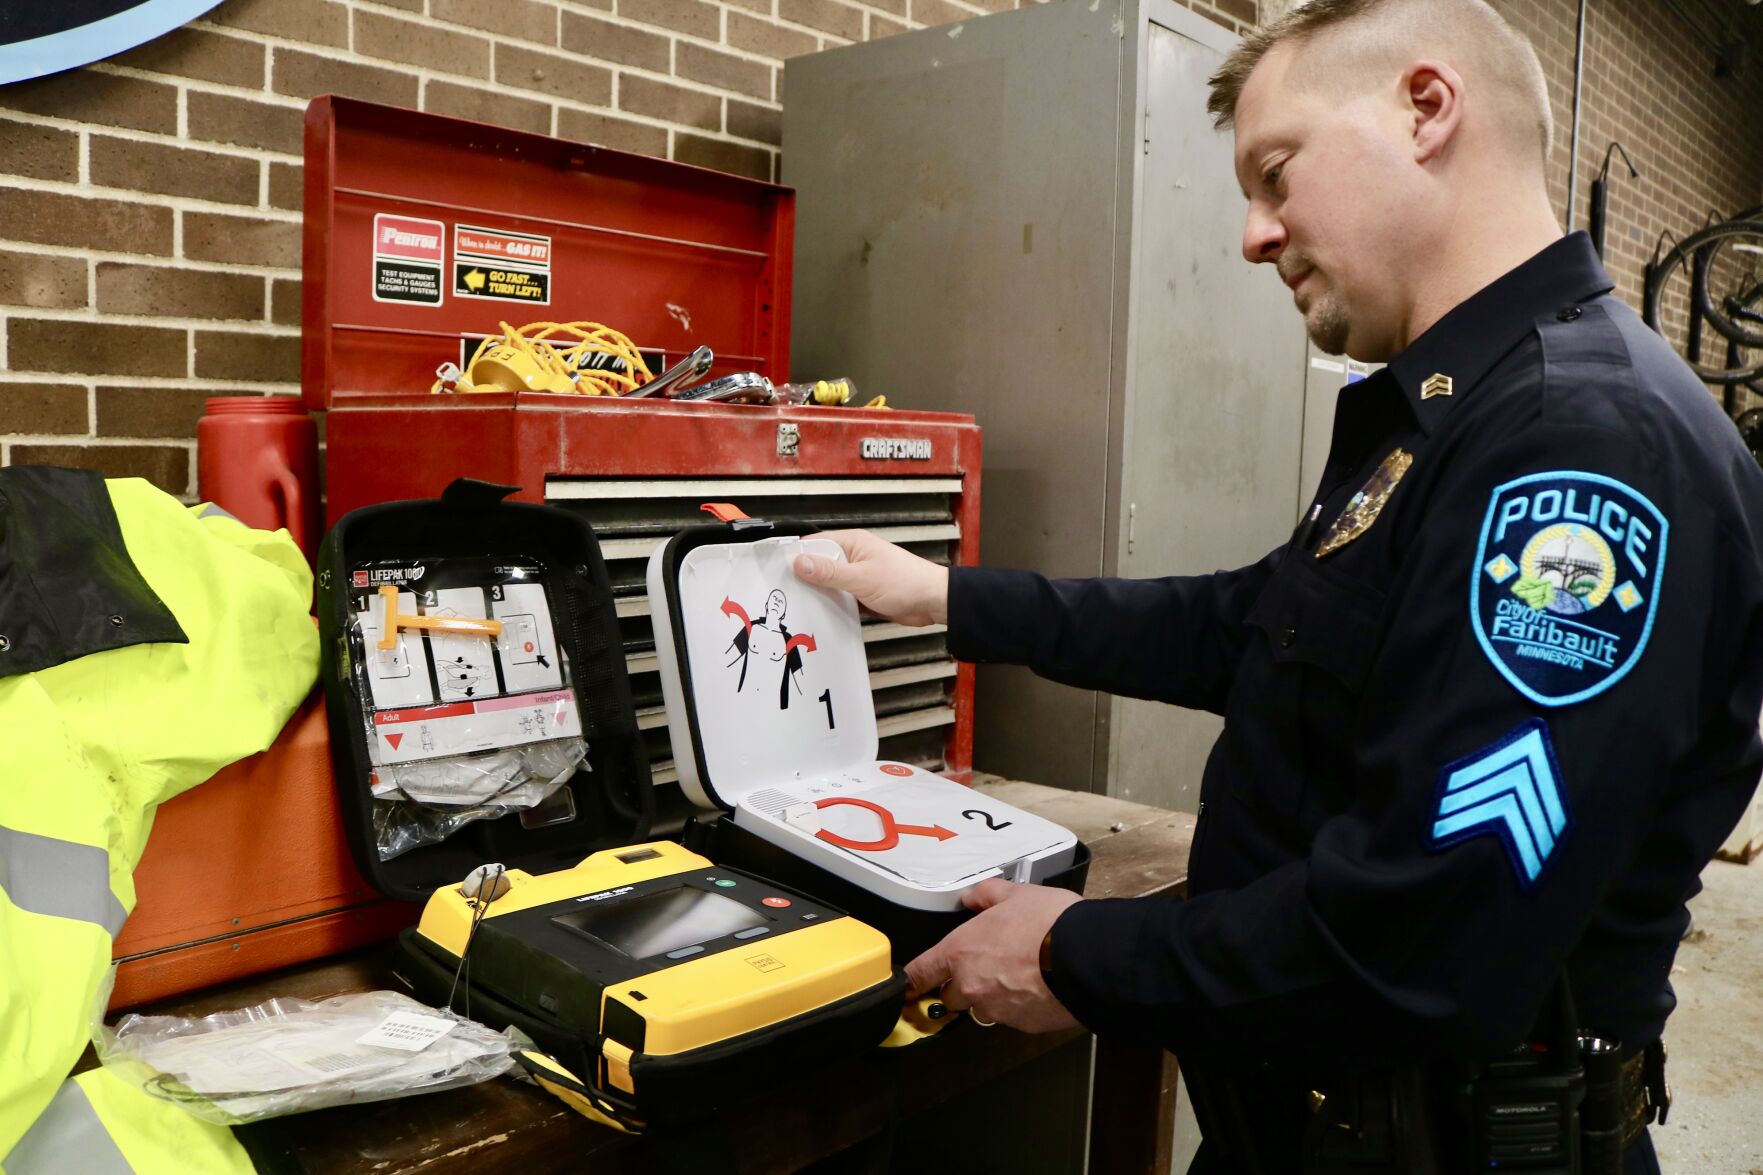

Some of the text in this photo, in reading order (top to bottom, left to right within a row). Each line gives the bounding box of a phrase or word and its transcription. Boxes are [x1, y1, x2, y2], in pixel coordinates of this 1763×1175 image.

[506, 242, 531, 256] GAS
[531, 245, 547, 258] IT!
[381, 276, 402, 285] TACHS
[410, 279, 436, 289] GAUGES
[382, 269, 435, 281] TEST EQUIPMENT
[489, 270, 506, 282] GO
[378, 284, 438, 296] SECURITY SYSTEMS
[488, 282, 542, 297] TURN LEFT!
[862, 438, 932, 459] CRAFTSMAN
[1493, 489, 1652, 579] POLICE
[370, 569, 404, 581] LIFEPAK
[425, 590, 435, 605] 2
[492, 586, 501, 600] 3
[358, 595, 365, 610] 1
[1496, 598, 1526, 620] City
[1492, 616, 1618, 664] Faribault
[1516, 644, 1584, 670] MINNESOTA
[818, 689, 835, 730] 1
[383, 713, 400, 722] Adult
[961, 809, 1012, 831] 2
[1496, 1106, 1546, 1114] MOTOROLA
